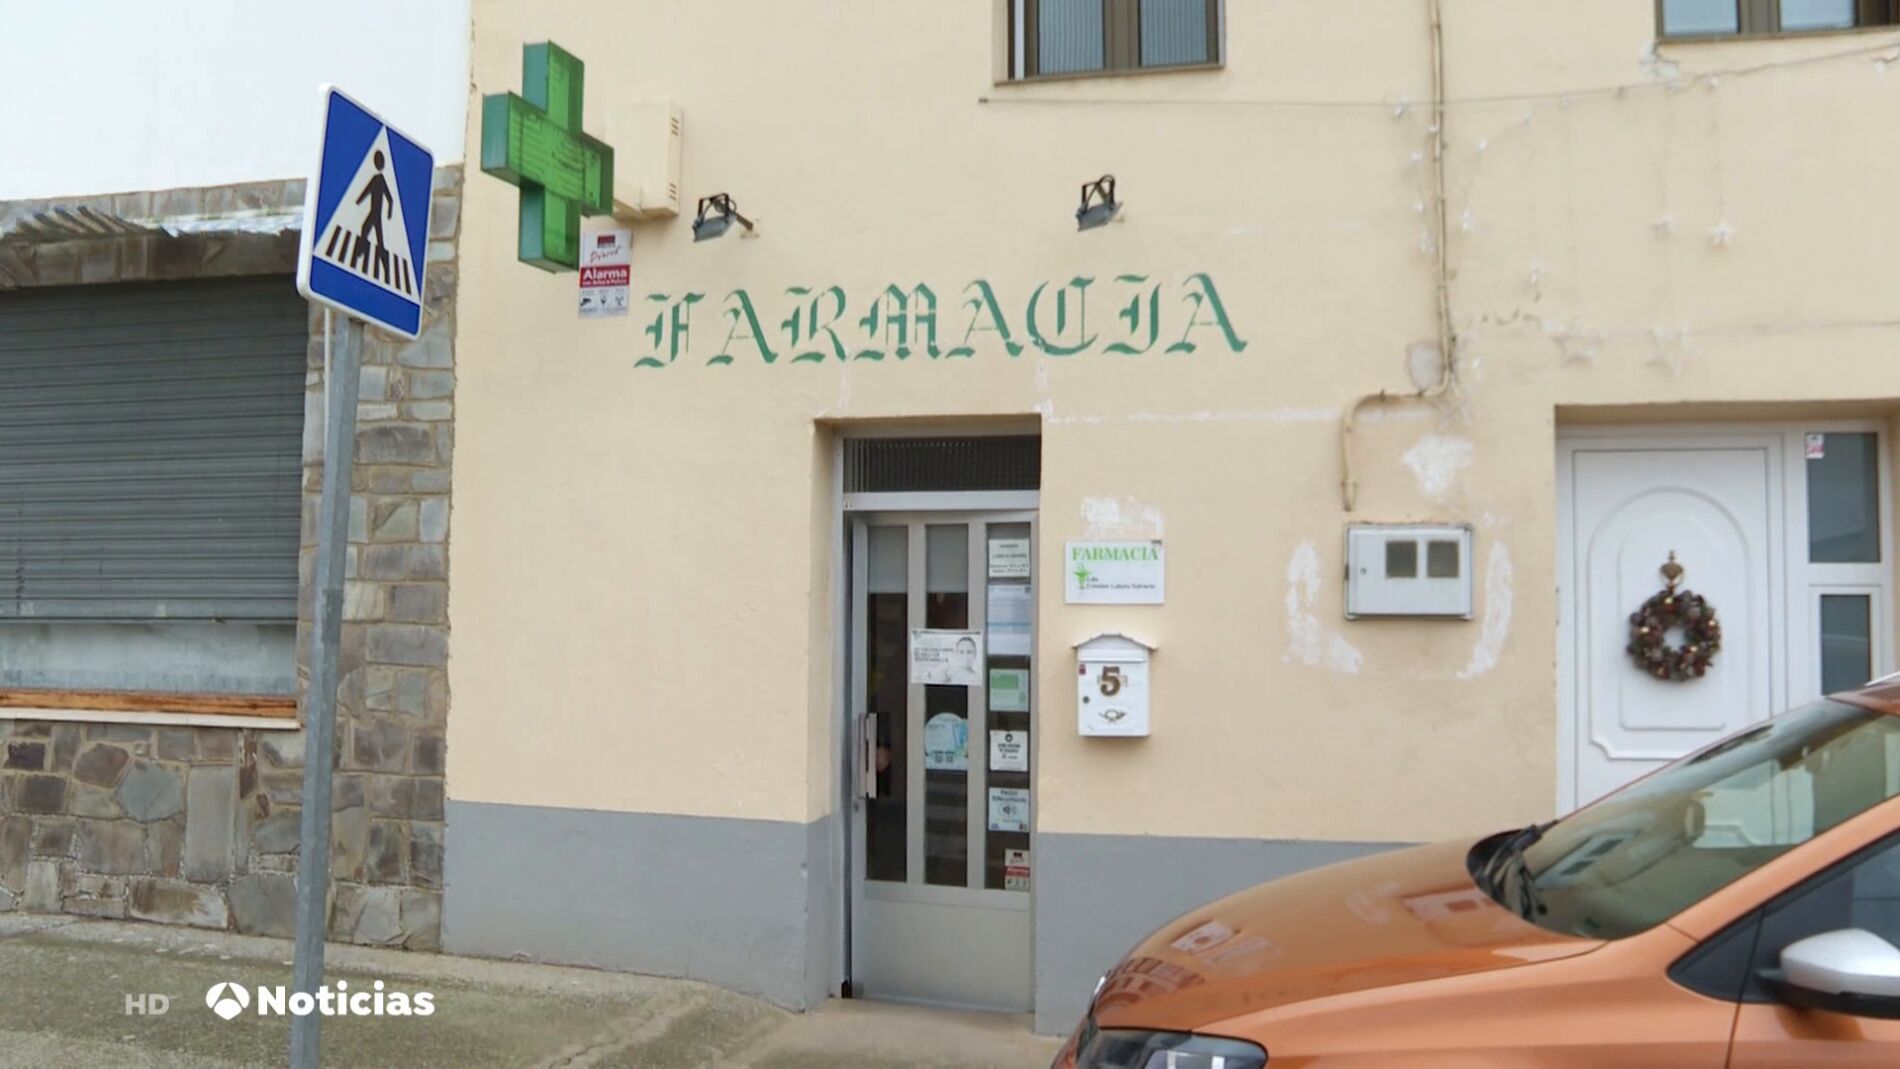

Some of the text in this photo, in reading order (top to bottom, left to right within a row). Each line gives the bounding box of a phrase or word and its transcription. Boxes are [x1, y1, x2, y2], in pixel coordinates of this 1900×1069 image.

[583, 267, 627, 281] Alarma
[633, 273, 1248, 368] FARMACIA
[1072, 546, 1159, 561] FARMACIA
[1100, 665, 1121, 697] 5
